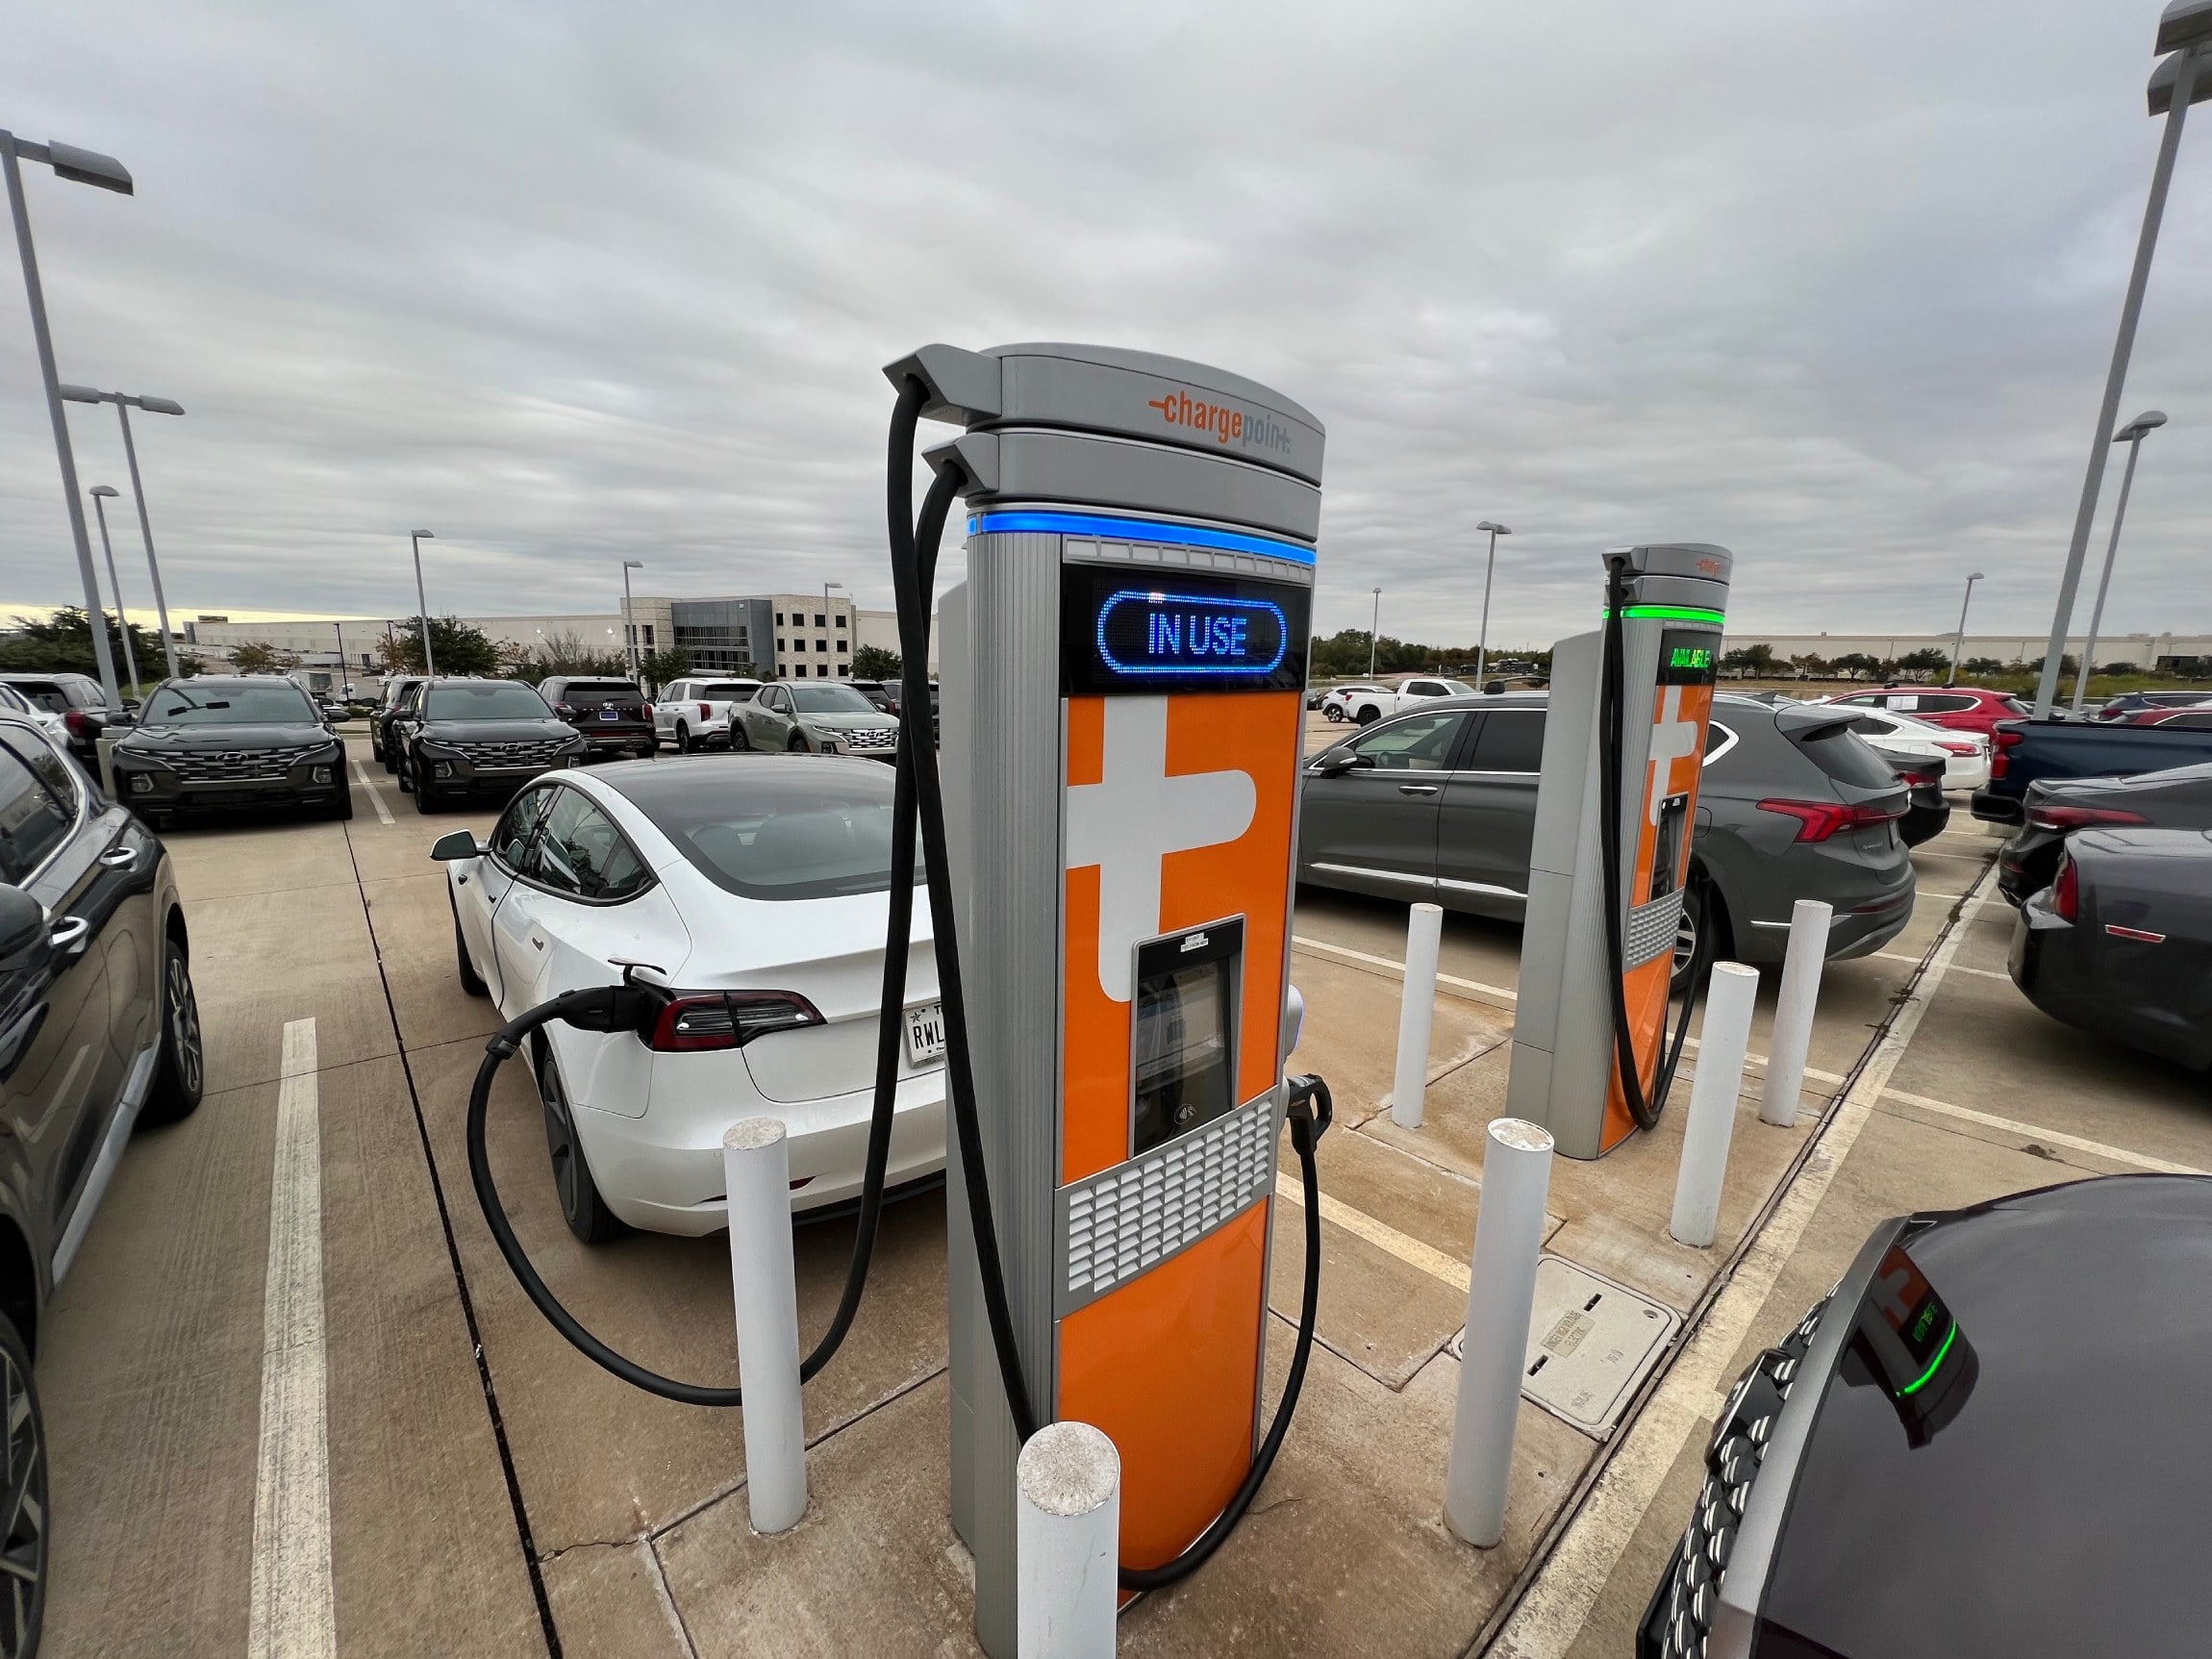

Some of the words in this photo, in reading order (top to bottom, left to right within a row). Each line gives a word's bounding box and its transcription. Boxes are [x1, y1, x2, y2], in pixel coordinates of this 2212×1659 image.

[1148, 390, 1292, 454] chargepoint
[1148, 613, 1181, 654] IN
[1189, 615, 1247, 655] USE
